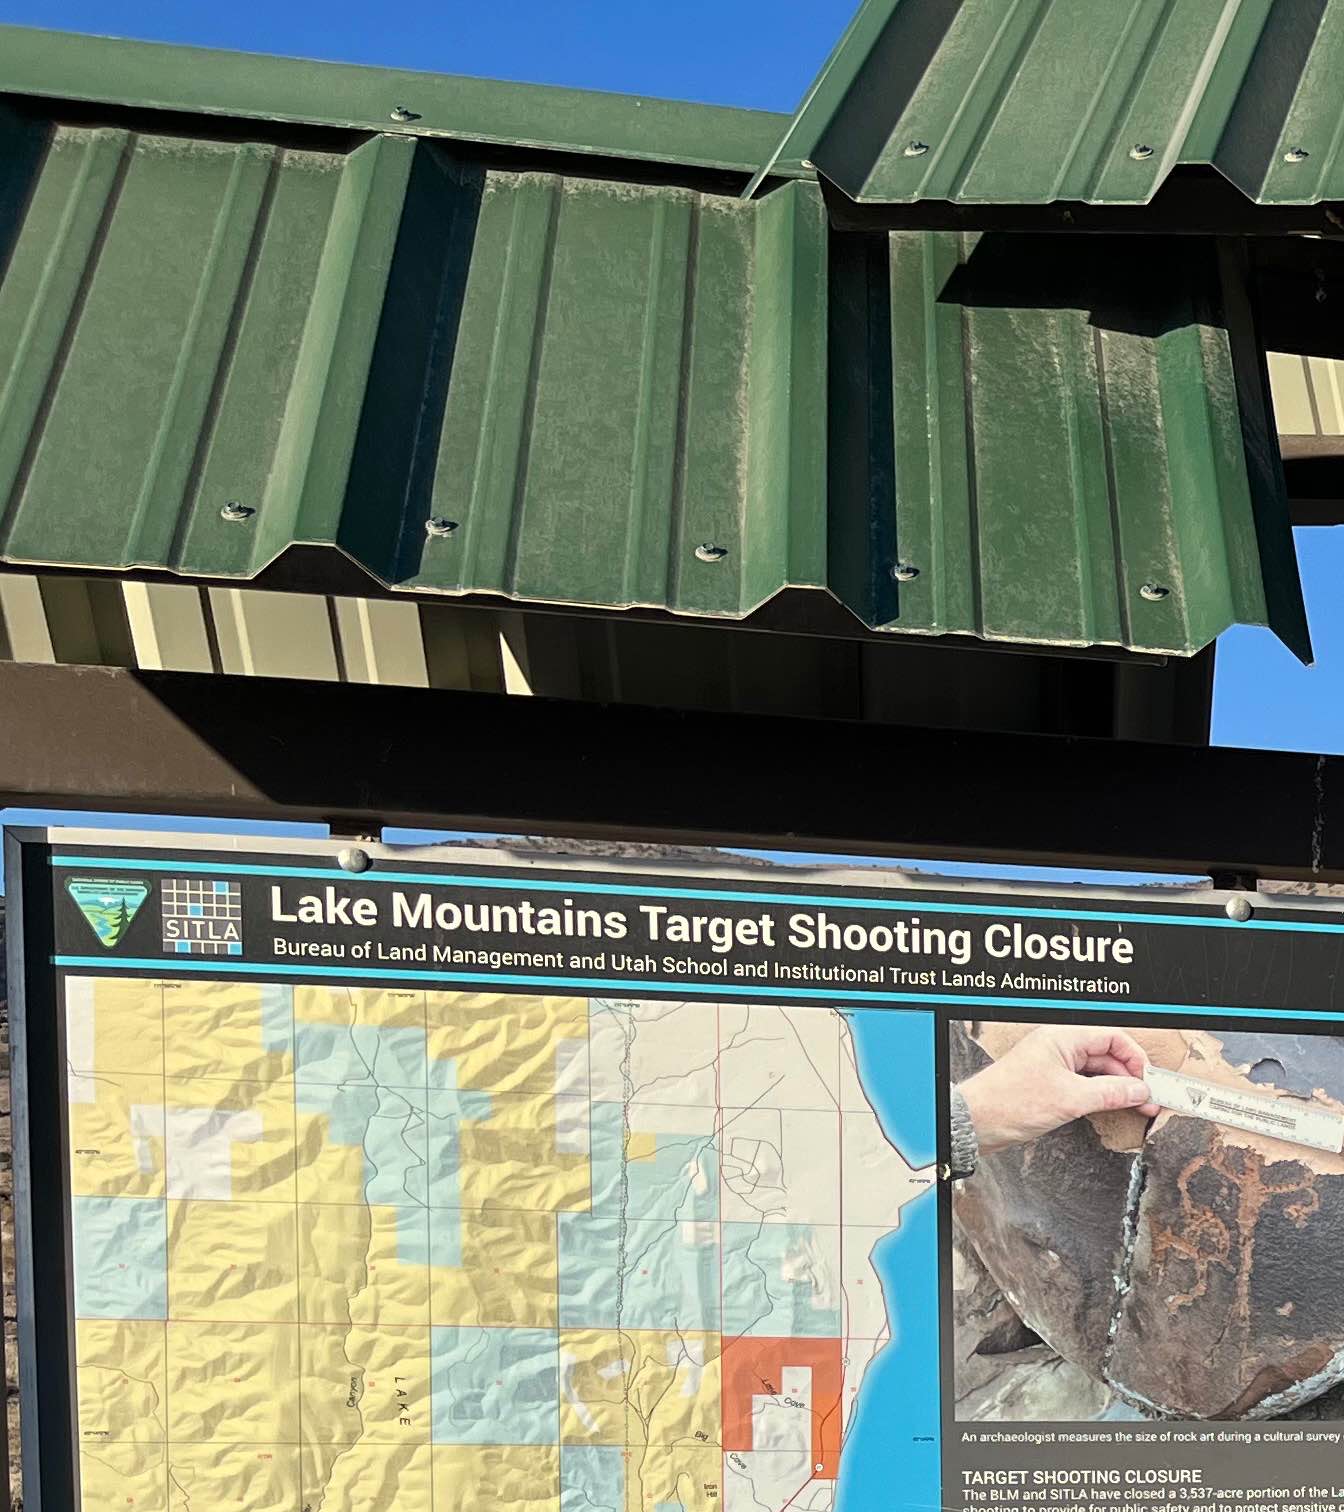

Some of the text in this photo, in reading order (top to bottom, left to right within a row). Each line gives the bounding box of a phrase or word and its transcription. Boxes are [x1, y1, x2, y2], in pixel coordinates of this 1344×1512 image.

[166, 919, 239, 940] SITLA
[272, 885, 1133, 965] Lake Mountains Target Shooting Closure
[274, 938, 1129, 994] Bureau of Land Management and Utah School and Institutional Trust Lands Administration
[962, 1433, 977, 1441] An
[980, 1432, 1055, 1444] archaeologist
[1115, 1432, 1132, 1441] the
[1136, 1432, 1157, 1441] size
[1160, 1432, 1171, 1441] of
[1174, 1432, 1197, 1441] rock
[1200, 1433, 1214, 1441] art
[1217, 1432, 1251, 1443] during
[1264, 1431, 1303, 1441] cultural
[1306, 1434, 1340, 1443] survey
[962, 1469, 1201, 1485] TARGET SHOOTING CLOSURE
